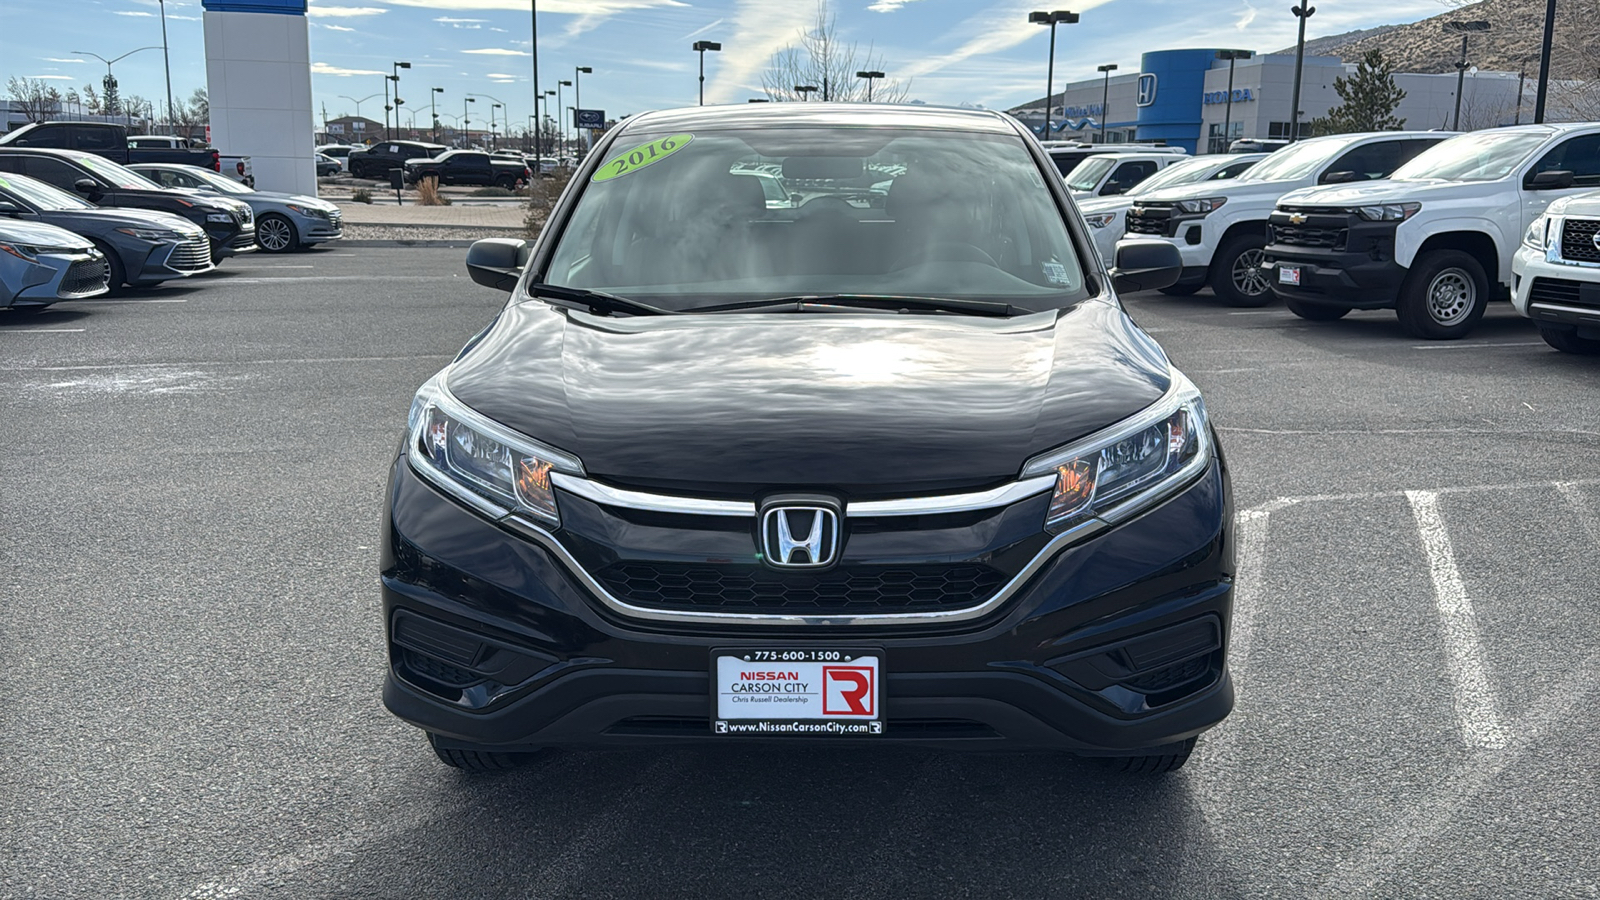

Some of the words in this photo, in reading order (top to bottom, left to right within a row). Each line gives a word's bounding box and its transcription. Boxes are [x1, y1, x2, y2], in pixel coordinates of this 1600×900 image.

[1203, 88, 1254, 104] HONDA
[612, 136, 676, 175] 2016
[754, 651, 840, 661] 775-600-1500
[740, 671, 799, 681] NISSAN
[731, 683, 781, 693] CARSON
[784, 683, 809, 692] CITY
[827, 670, 870, 713] R
[732, 695, 749, 703] Chris
[750, 695, 772, 703] Russell
[773, 695, 808, 704] Dealership
[729, 721, 868, 734] www.NissanCarsonCity.com
